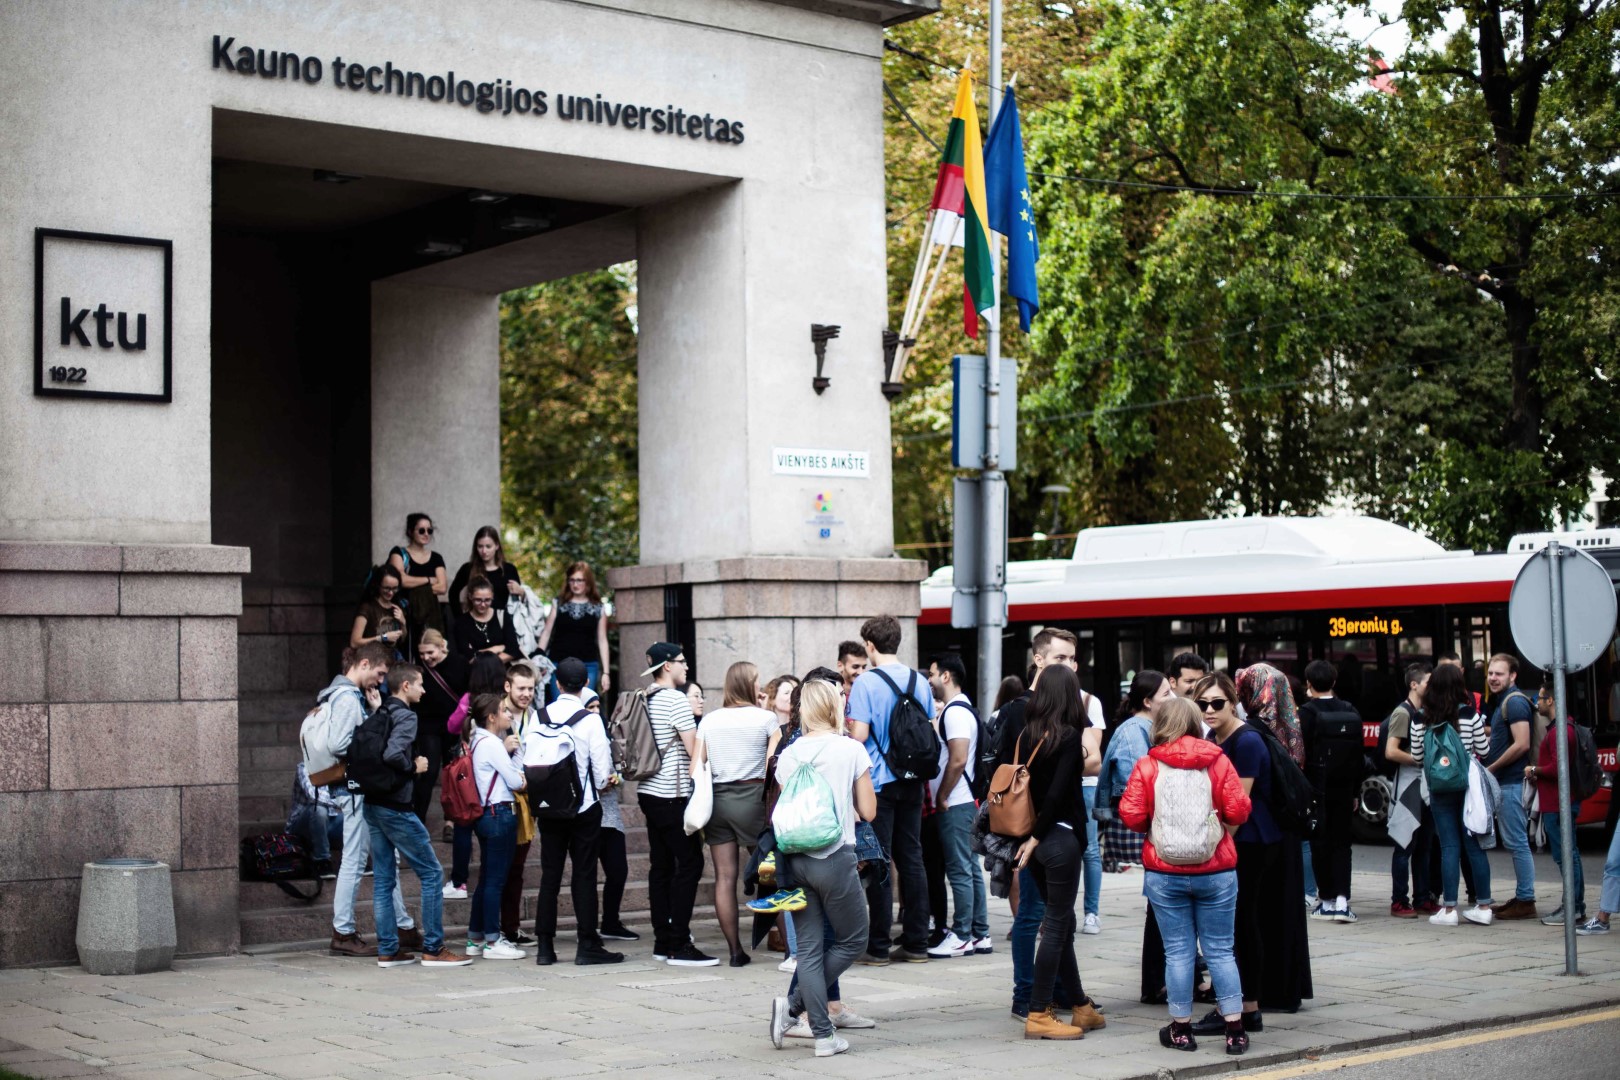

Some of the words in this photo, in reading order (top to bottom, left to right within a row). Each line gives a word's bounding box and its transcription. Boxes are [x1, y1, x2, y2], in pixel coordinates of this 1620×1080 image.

[212, 34, 323, 85] Kauno
[331, 56, 548, 117] technologijos
[556, 93, 745, 145] universitetas
[60, 296, 147, 352] ktu
[49, 365, 87, 384] 1922
[1363, 725, 1380, 737] 776
[1597, 753, 1615, 765] 776
